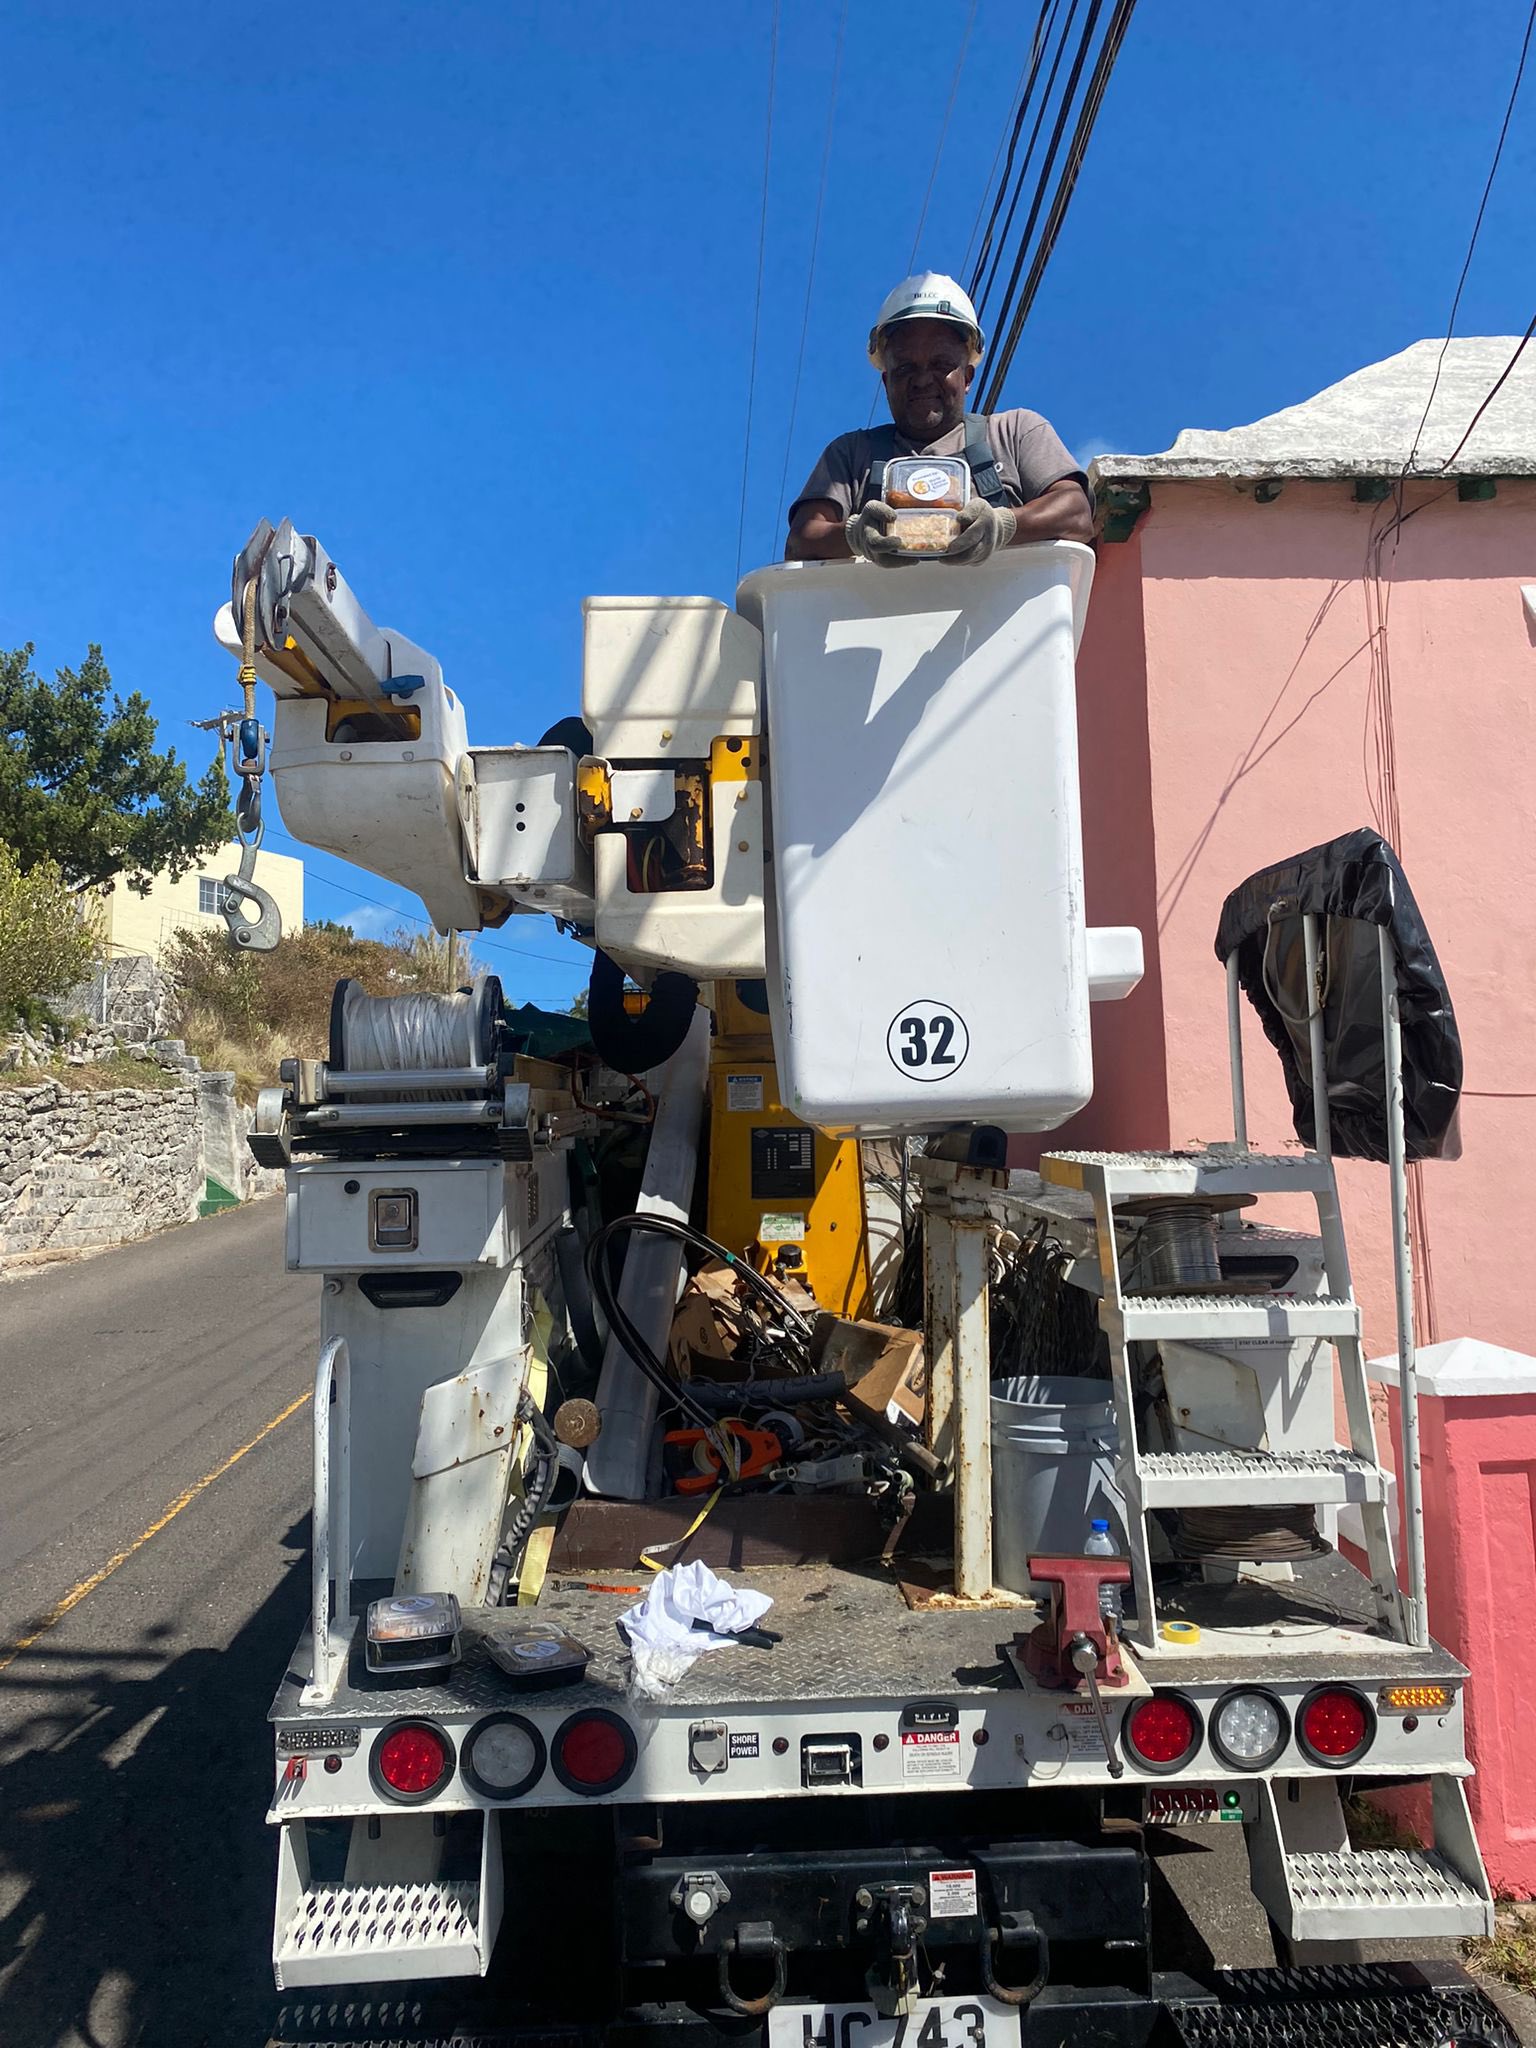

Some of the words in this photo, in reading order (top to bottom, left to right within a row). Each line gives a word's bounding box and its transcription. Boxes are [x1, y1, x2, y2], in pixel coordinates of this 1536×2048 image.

[900, 1015, 956, 1067] 32
[1074, 1704, 1113, 1714] DANER
[731, 1735, 758, 1745] SHORE
[917, 1732, 957, 1743] DANGER
[731, 1746, 758, 1756] POWER
